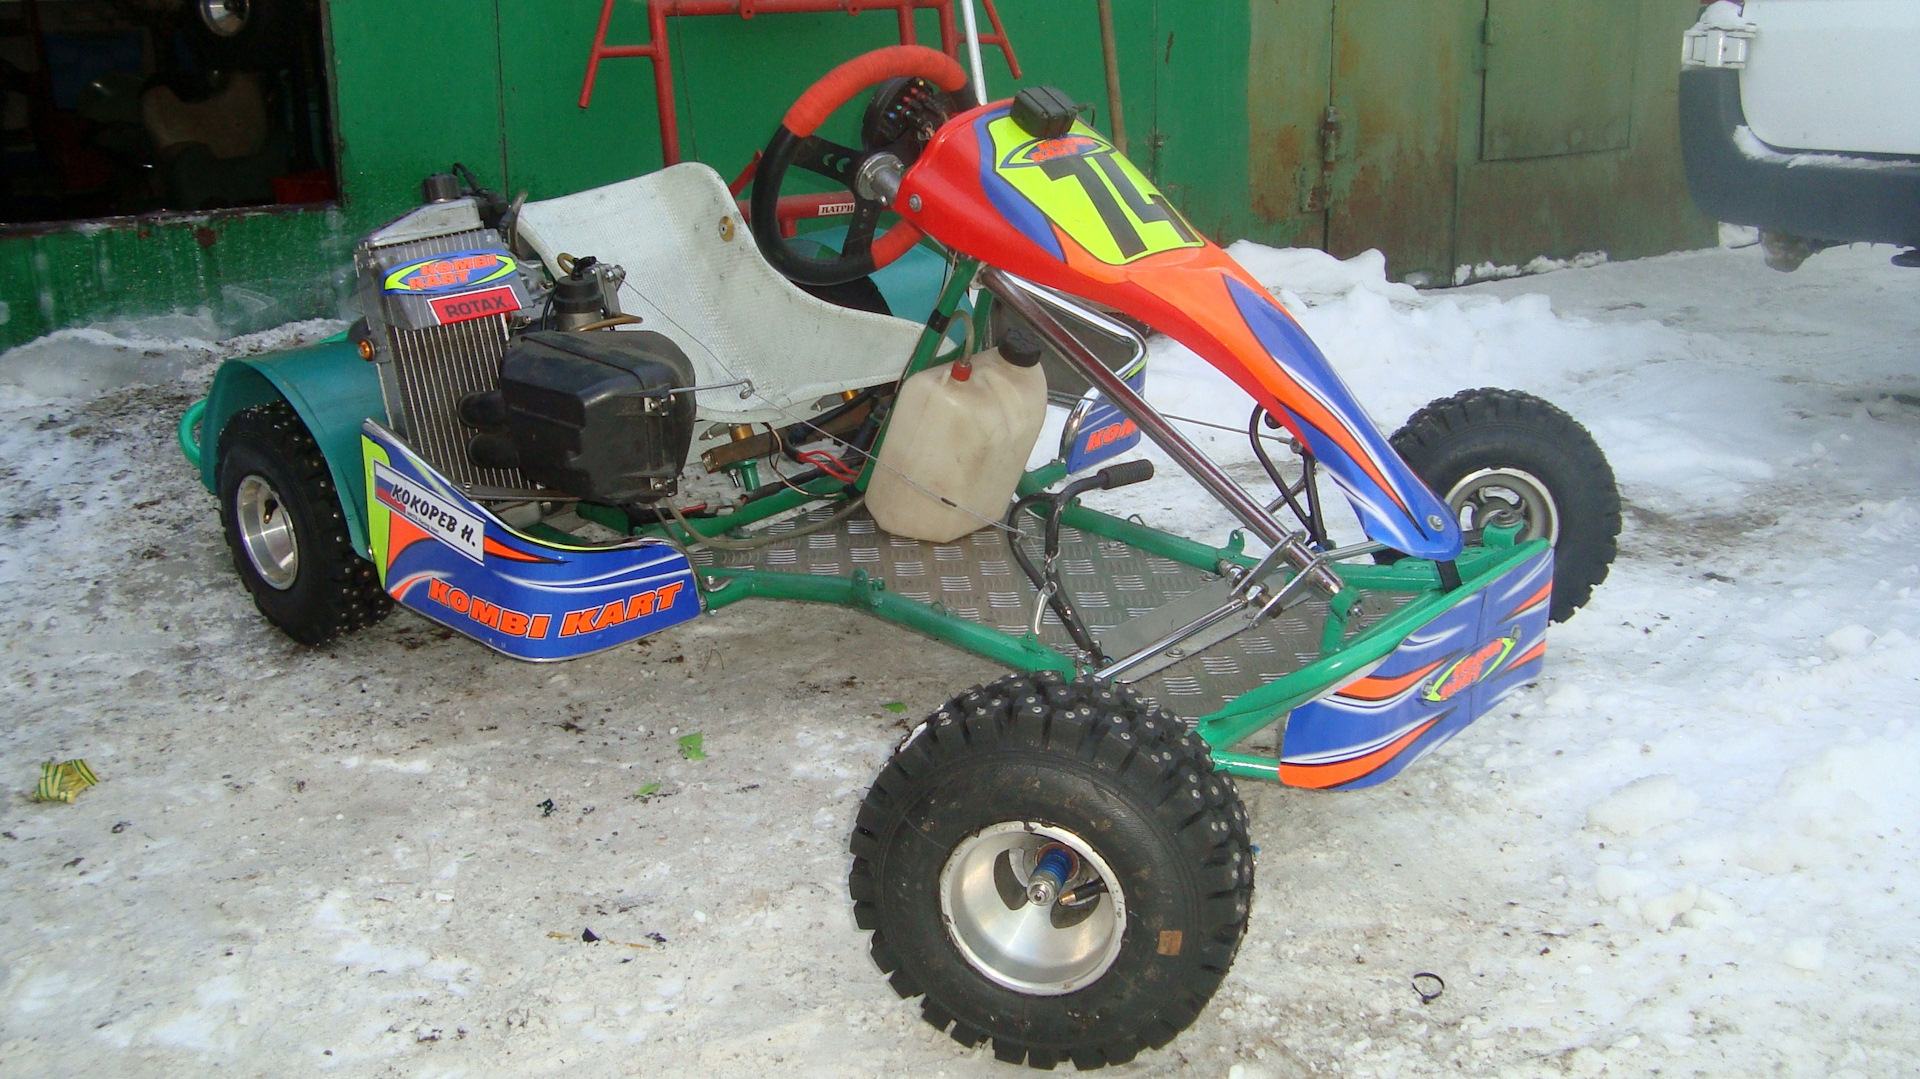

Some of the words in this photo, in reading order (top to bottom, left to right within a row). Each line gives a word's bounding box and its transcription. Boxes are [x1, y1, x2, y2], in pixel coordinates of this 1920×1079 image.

[420, 253, 498, 276] KOMBI
[408, 270, 470, 290] KART
[444, 295, 507, 318] ROTAX
[392, 484, 458, 533] КОКОРЕВ
[428, 577, 552, 639] KOMBI
[558, 580, 684, 638] KART
